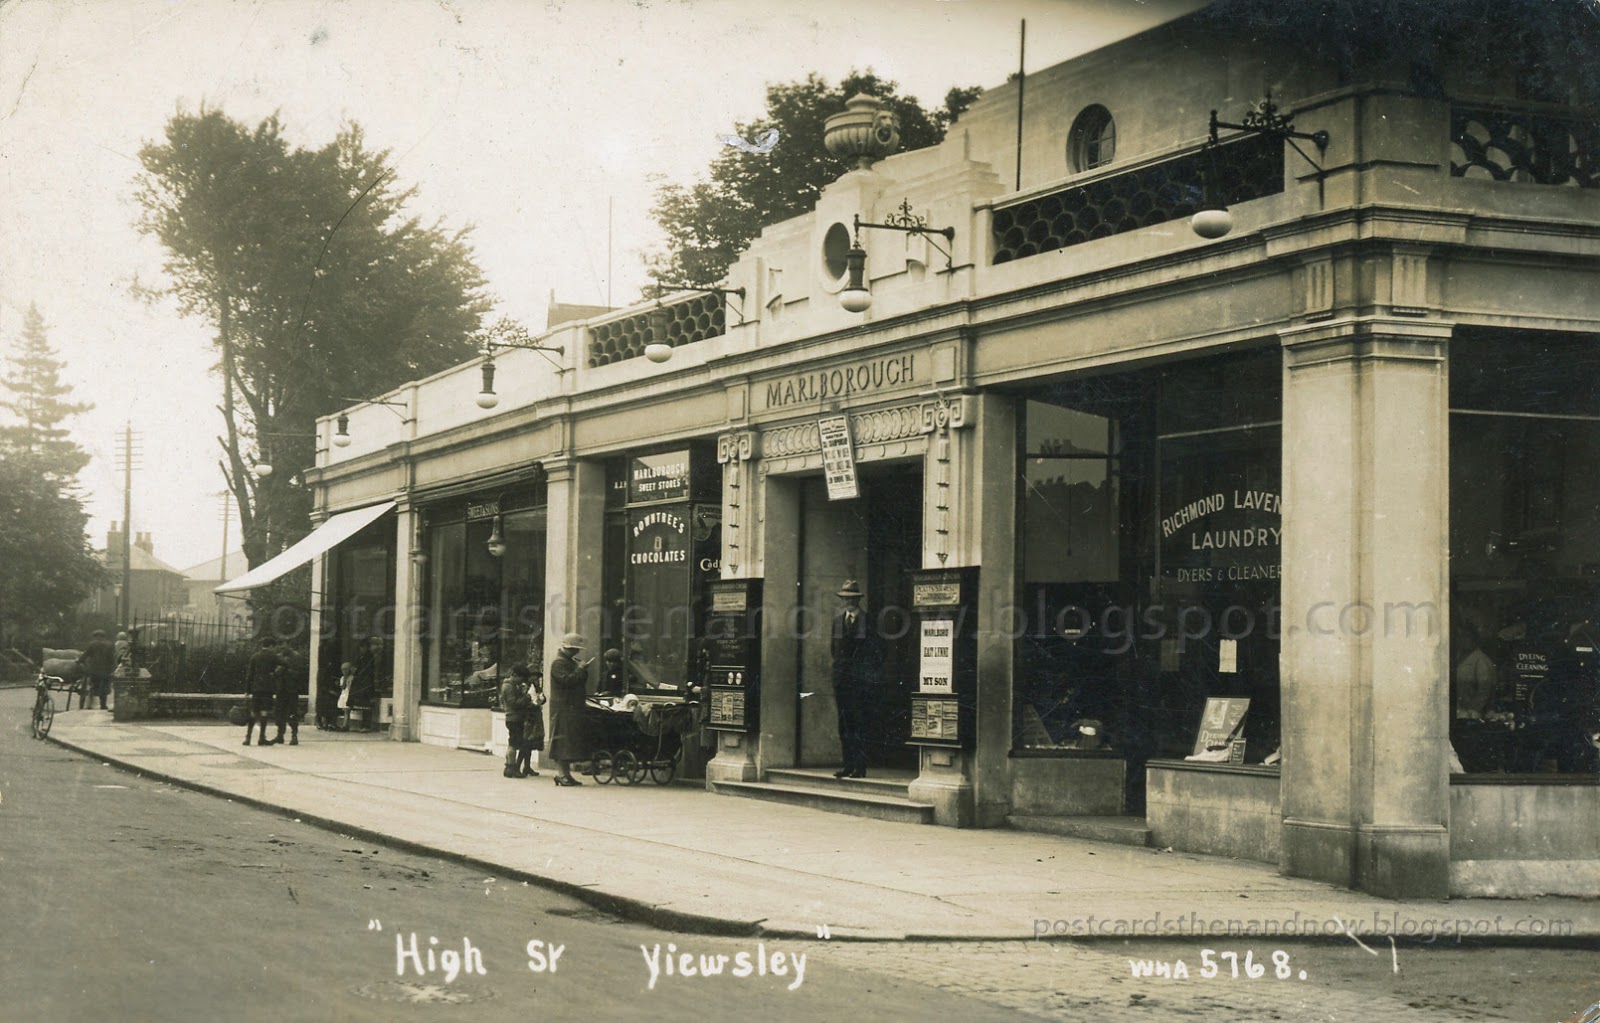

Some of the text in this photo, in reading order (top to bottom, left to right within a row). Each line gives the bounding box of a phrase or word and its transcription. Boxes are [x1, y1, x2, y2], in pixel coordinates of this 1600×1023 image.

[766, 354, 914, 409] MARLBOROUGH
[633, 463, 685, 481] MARLBOROUGH
[638, 479, 681, 492] SWEET STORES
[1161, 493, 1225, 538] RICHMOND
[633, 512, 685, 537] ROWNTREE'S
[1191, 527, 1282, 550] LAUNDRY
[631, 550, 685, 564] CHOCOLATES
[700, 558, 721, 572] Cad
[1177, 568, 1212, 582] DYERS
[923, 676, 948, 686] MY SON
